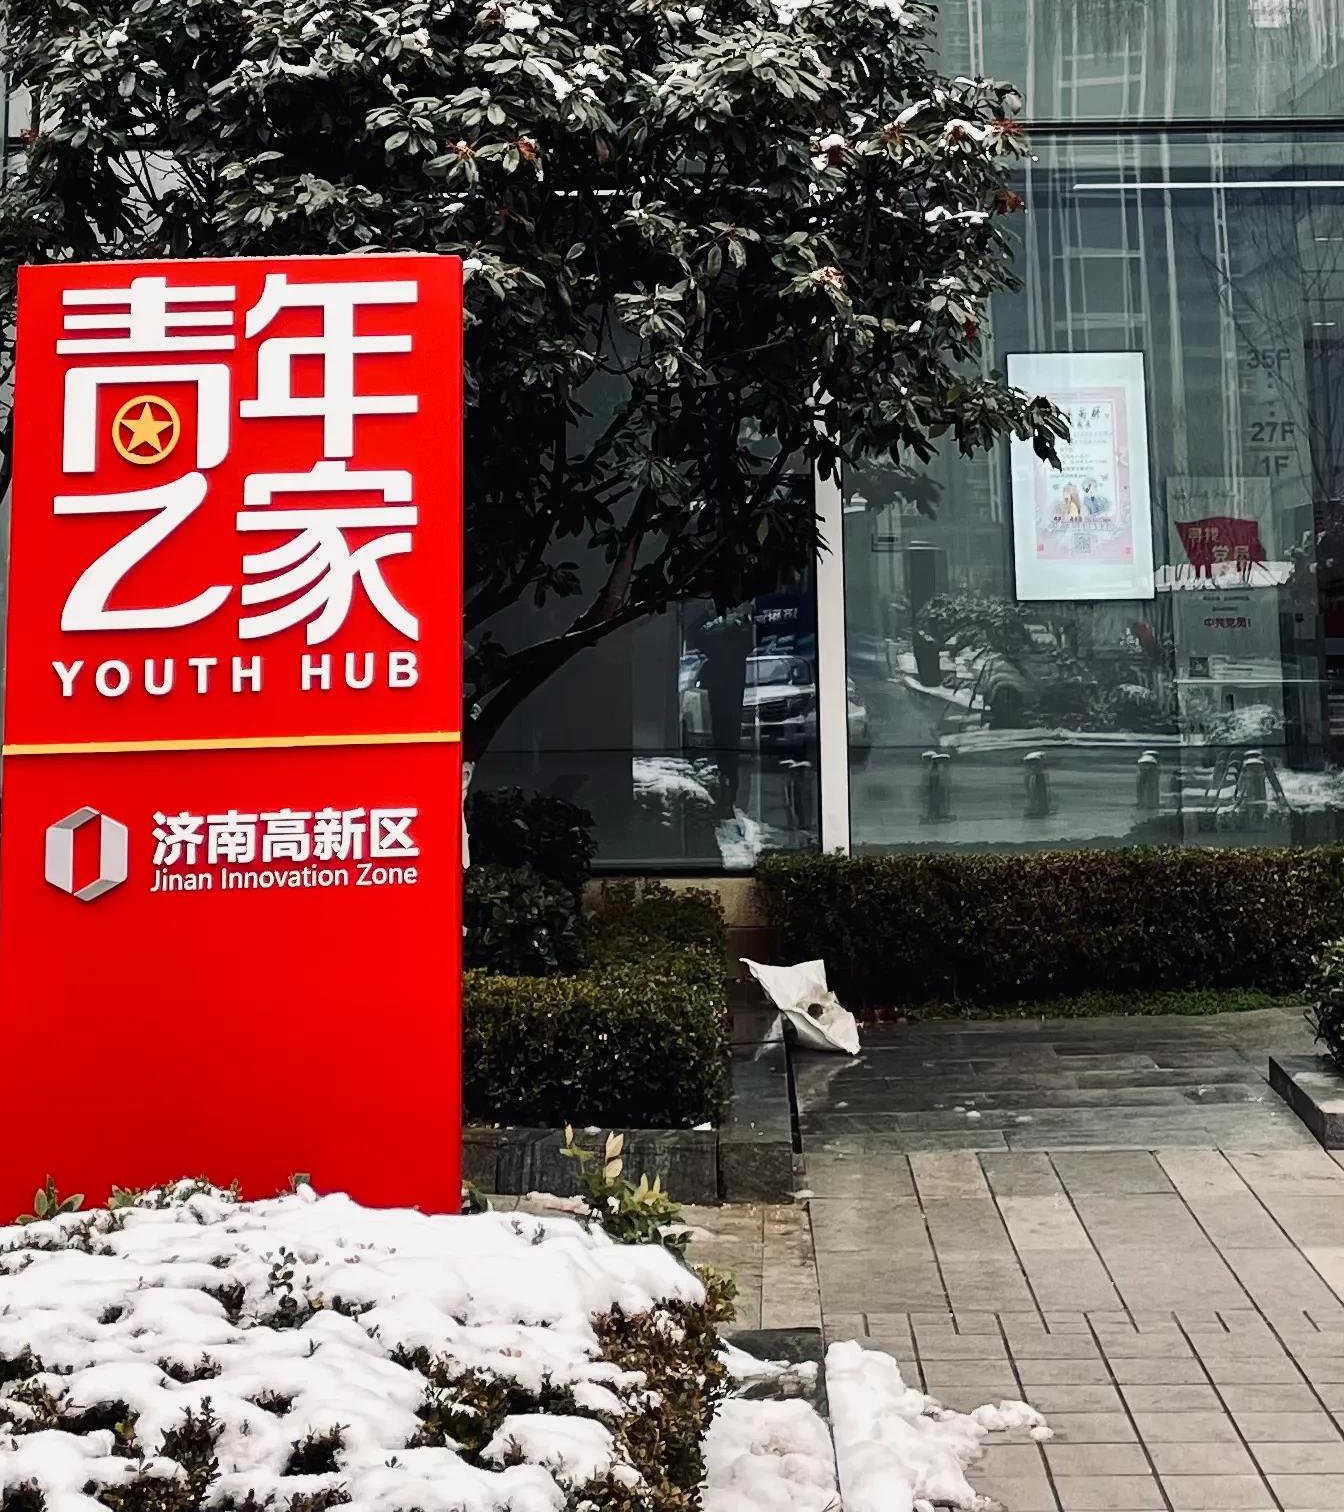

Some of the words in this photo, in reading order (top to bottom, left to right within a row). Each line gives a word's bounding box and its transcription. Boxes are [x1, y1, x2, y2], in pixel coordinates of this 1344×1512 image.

[56, 273, 420, 474] 青年
[53, 460, 420, 647] 之家
[52, 655, 262, 698] YOUTH
[301, 651, 420, 691] HUB
[151, 806, 420, 866] 济南高新区
[150, 869, 213, 892] Jinan
[221, 864, 349, 890] Innovation
[355, 862, 419, 887] Zone
